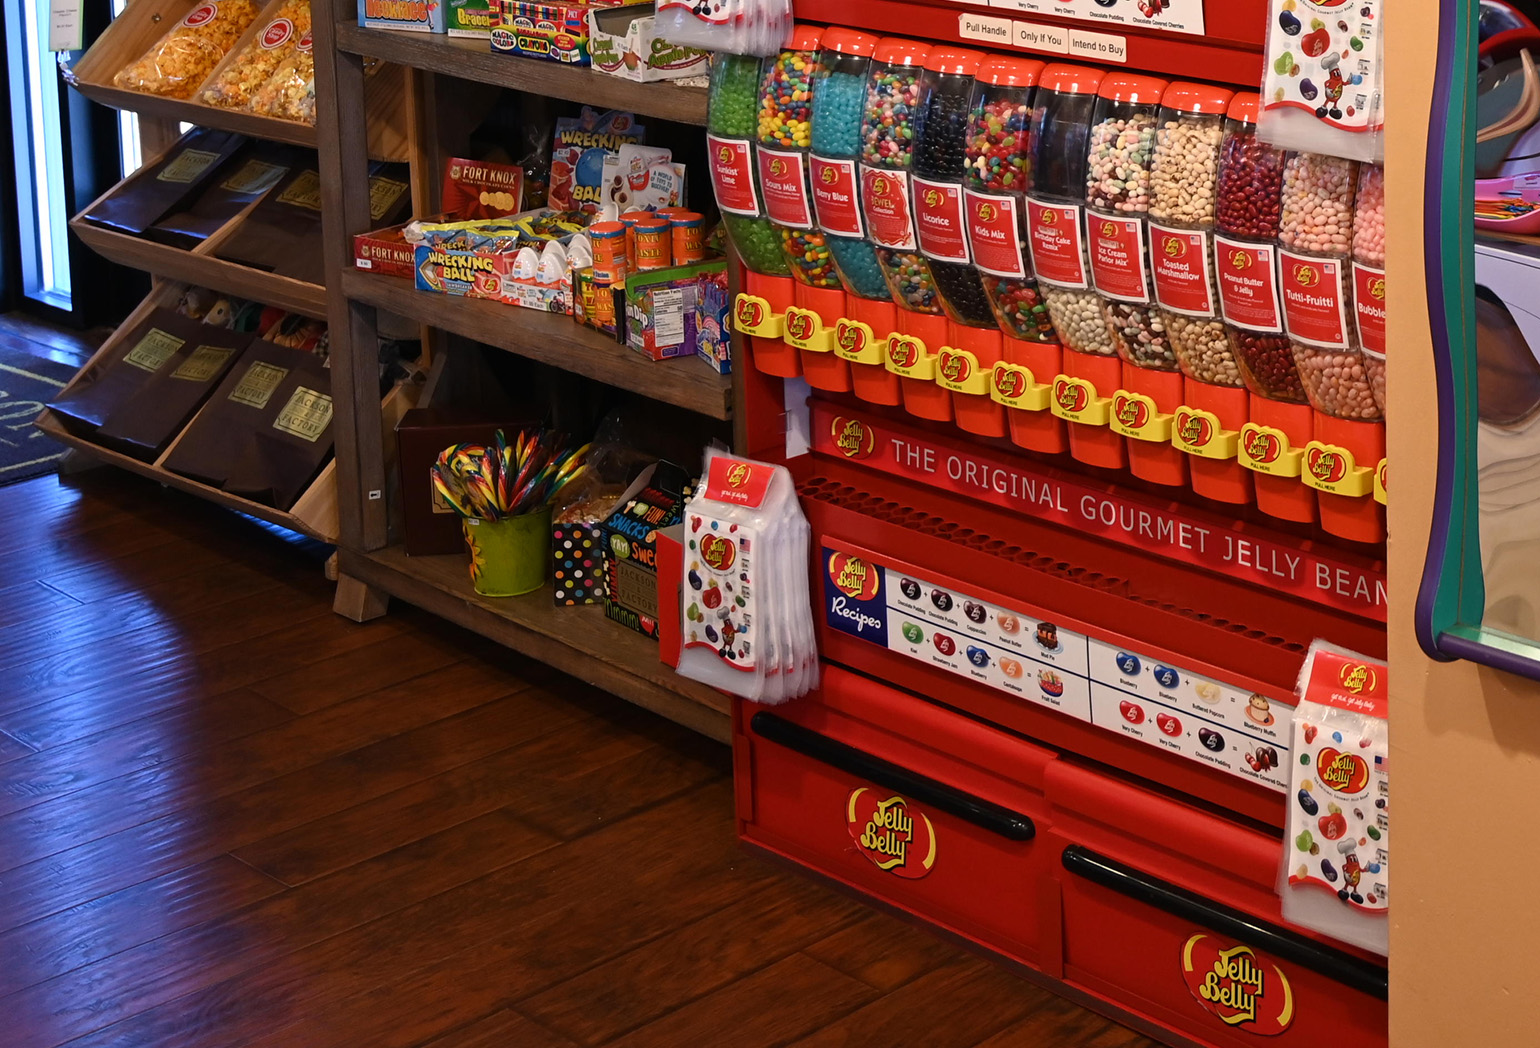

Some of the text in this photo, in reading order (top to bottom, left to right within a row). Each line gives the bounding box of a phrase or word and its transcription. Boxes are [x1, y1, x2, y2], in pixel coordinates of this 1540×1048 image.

[965, 22, 1124, 57] Pull Handle Only If You Intend to Buy
[463, 165, 489, 179] FORT
[489, 169, 516, 185] KNOX
[716, 164, 740, 176] Sunkist
[721, 174, 736, 185] Lime
[782, 182, 797, 192] Mix
[832, 191, 849, 202] Blue
[922, 212, 950, 226] Licorice
[975, 225, 1006, 241] Kids Mix
[1034, 233, 1071, 246] Birthday Cake
[371, 246, 392, 260] FORT
[393, 250, 415, 263] KNOX
[428, 252, 494, 273] WRECKING
[1107, 249, 1127, 259] Cream
[1157, 265, 1200, 280] Marshmallow
[1162, 258, 1189, 271] Toasted
[443, 266, 475, 282] BALL
[1223, 272, 1263, 288] Peanut Butter
[1239, 285, 1253, 297] Jelly
[1286, 289, 1334, 308] Tutti-Fruitti
[633, 305, 648, 329] Dip
[608, 513, 649, 540] SNACKS
[891, 439, 1387, 606] THE ORIGINAL GOURMET JELLY BEAN
[845, 558, 867, 580] Jelly
[838, 571, 863, 595] Belly
[831, 596, 881, 632] Recipes
[872, 800, 913, 842] Jelly
[861, 822, 905, 864] Belly
[1214, 947, 1264, 997] Jelly
[1199, 971, 1256, 1020] Belly
